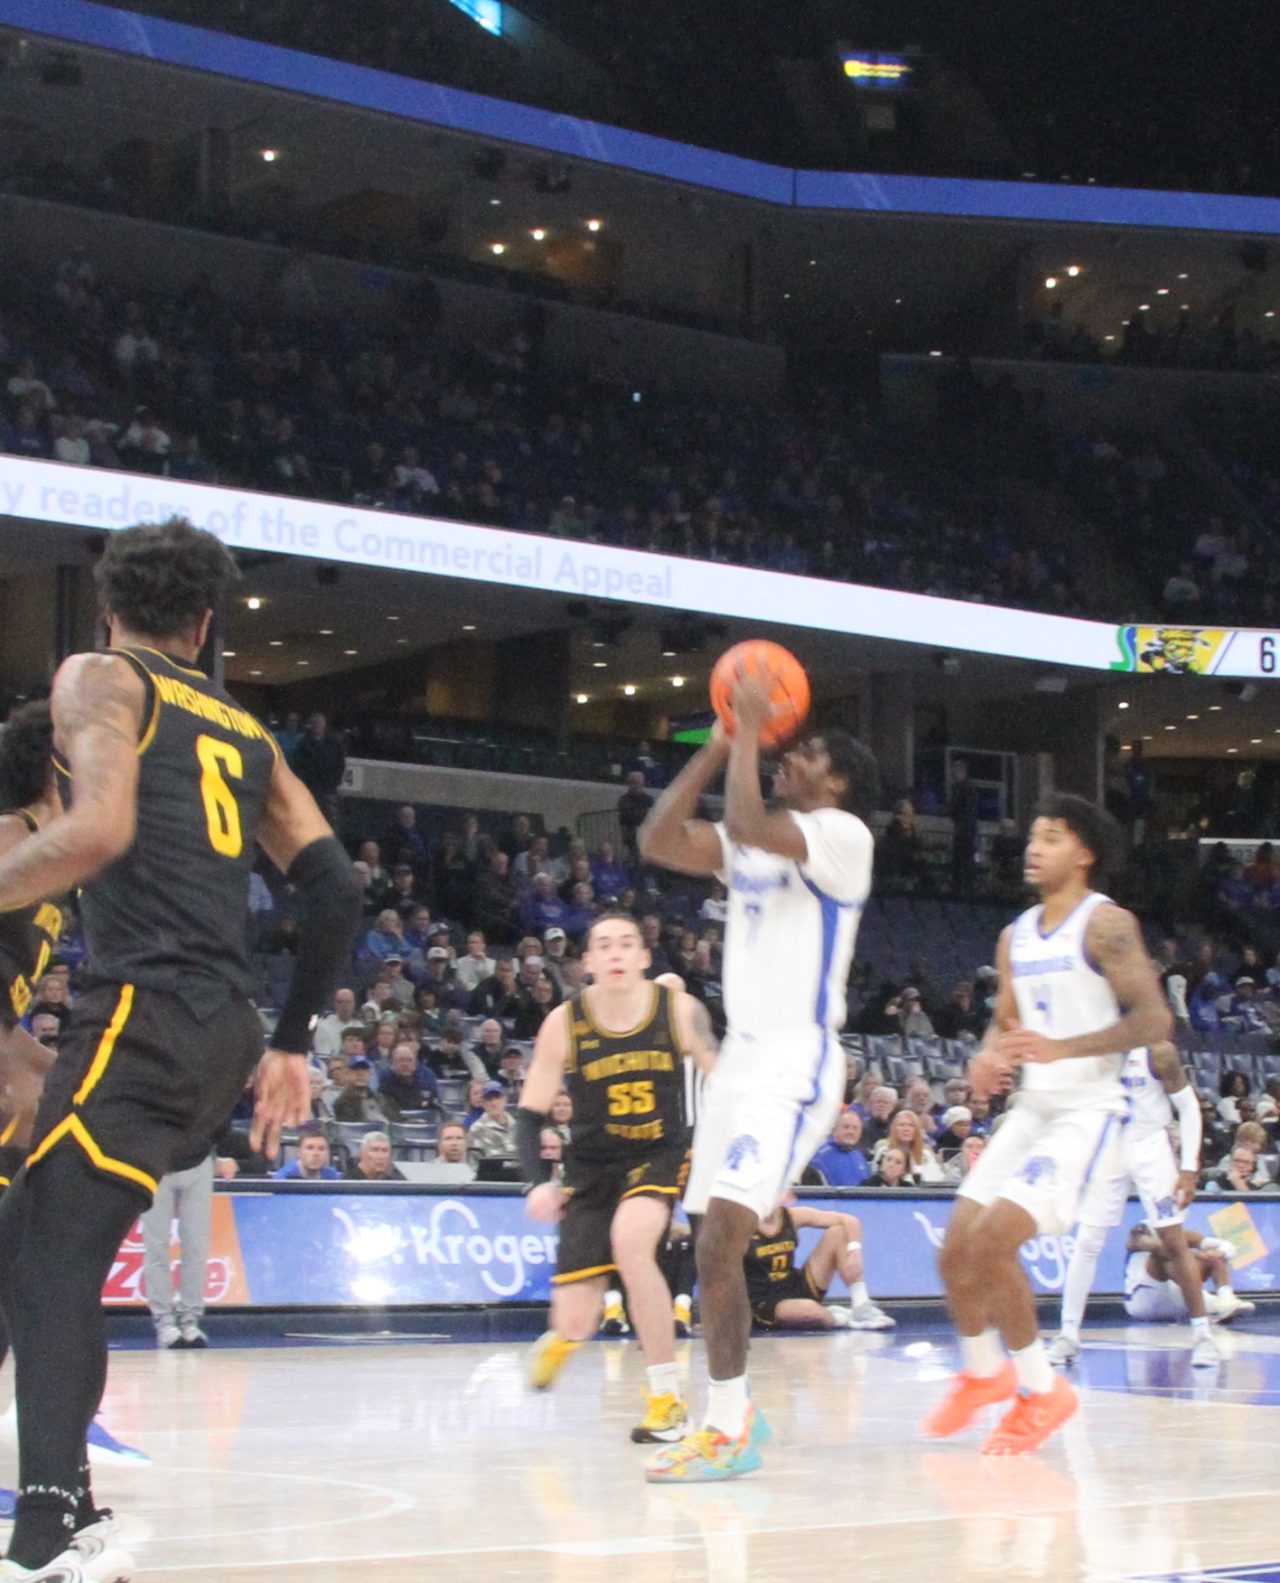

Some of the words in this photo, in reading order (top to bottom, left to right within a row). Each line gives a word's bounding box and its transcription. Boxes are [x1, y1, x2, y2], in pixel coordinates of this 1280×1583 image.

[40, 485, 191, 525] readers
[205, 502, 249, 536] of
[259, 509, 321, 548] the
[333, 518, 543, 581] Commercial
[554, 551, 673, 602] Appeal
[195, 733, 244, 859] 6
[607, 1080, 656, 1117] 55
[411, 1199, 560, 1296] Kroger
